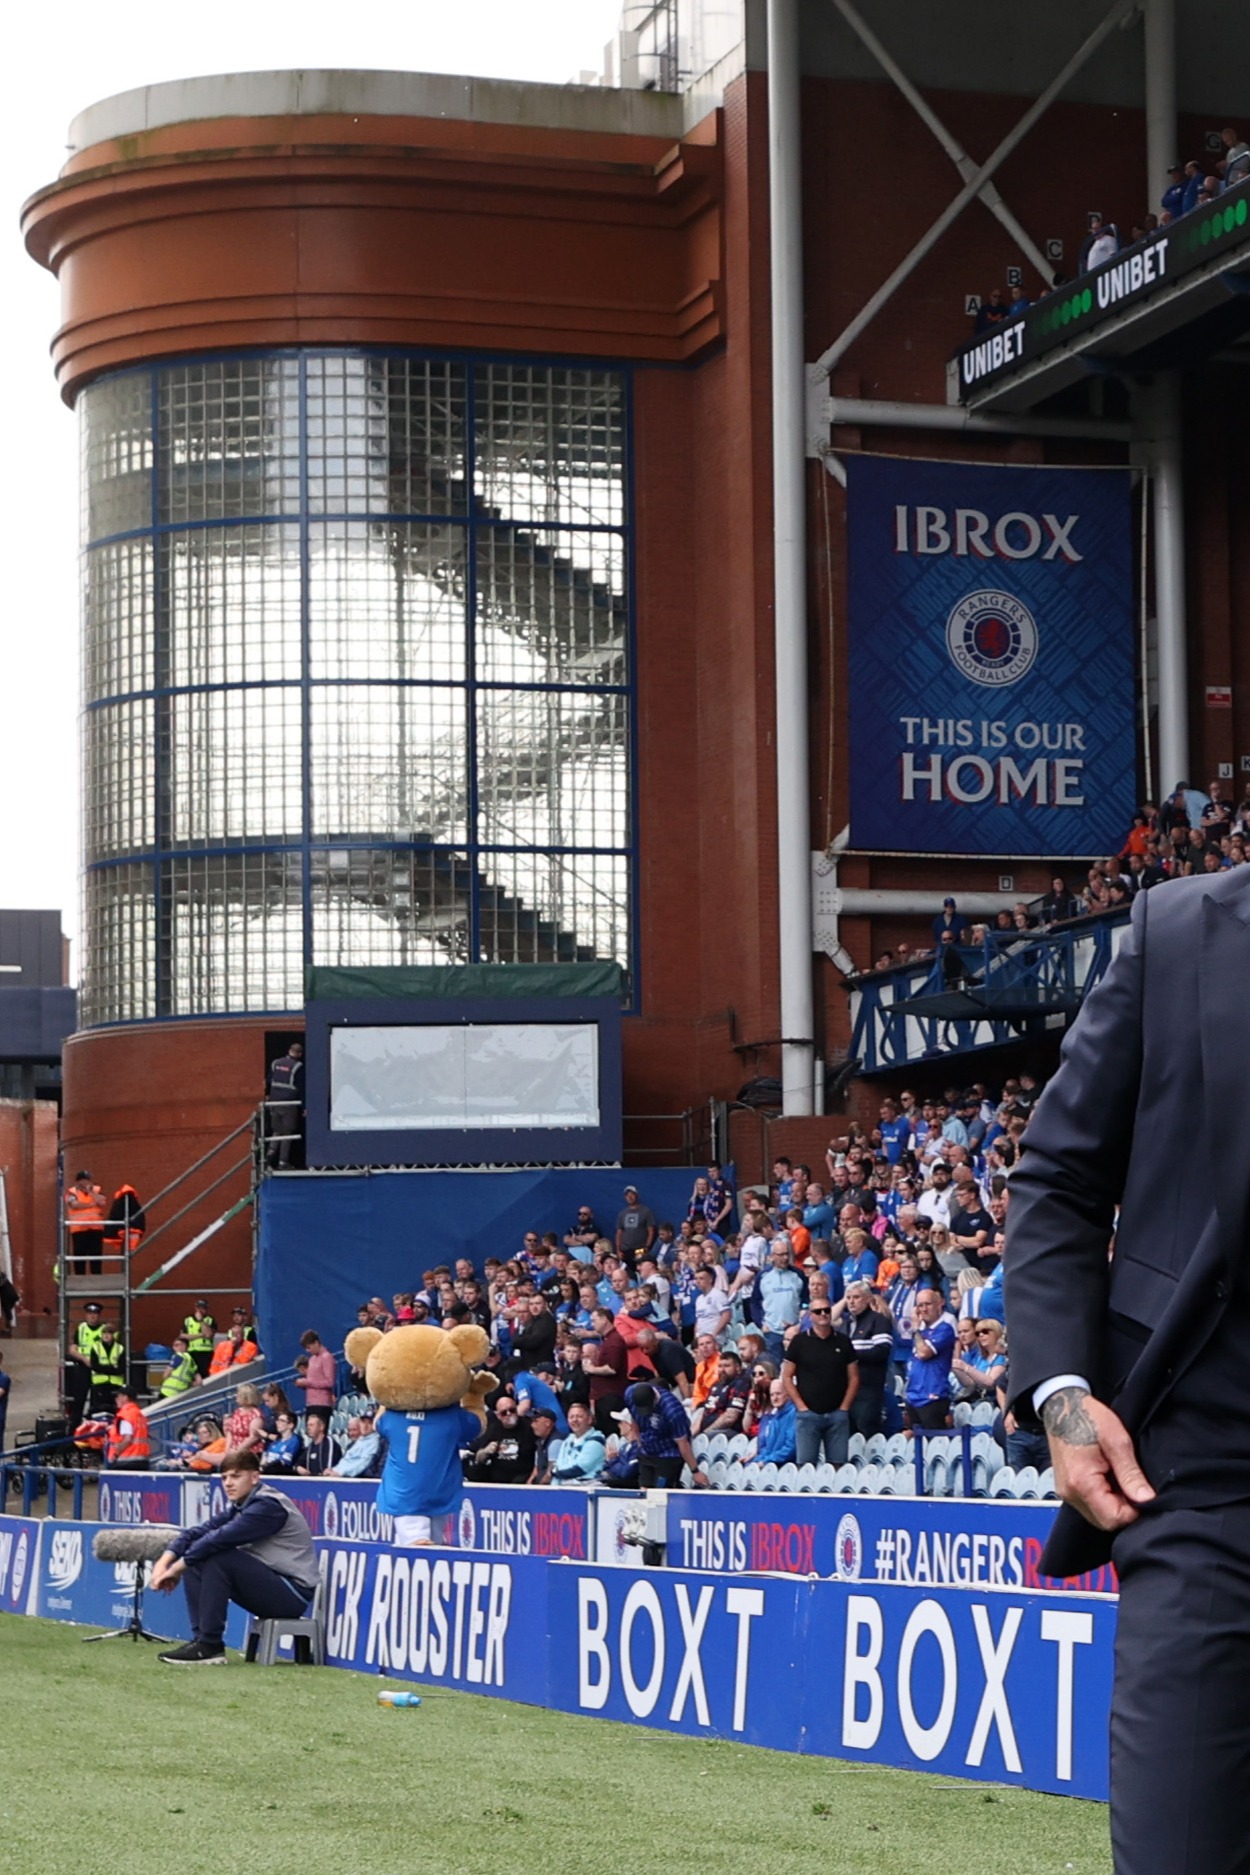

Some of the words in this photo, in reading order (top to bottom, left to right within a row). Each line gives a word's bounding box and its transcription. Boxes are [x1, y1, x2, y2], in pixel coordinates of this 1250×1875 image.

[1049, 241, 1062, 258] C
[1008, 269, 1021, 285] B
[1097, 238, 1168, 309] UNIBET
[967, 298, 981, 313] A
[963, 320, 1026, 384] UNIBET
[895, 504, 1084, 562] IBROX
[958, 595, 1027, 624] RANGERS
[954, 644, 1009, 680] FOOTBALL
[1008, 647, 1031, 675] CLUB
[900, 717, 974, 747] THIS
[981, 720, 1008, 748] IS
[1014, 722, 1087, 751] OUR
[902, 752, 1085, 805] HOME
[407, 1425, 420, 1463] 1
[114, 1490, 132, 1522] THIS
[341, 1501, 394, 1542] FOLLOW
[481, 1509, 514, 1553] THIS
[517, 1511, 531, 1555] IS
[534, 1513, 585, 1558] IBROX
[681, 1519, 724, 1570] THIS
[729, 1521, 747, 1571] IS
[752, 1522, 816, 1573] IBROX
[312, 1549, 367, 1661] ACK
[365, 1554, 512, 1687] ROOSTER
[578, 1576, 764, 1732] BOXT
[842, 1595, 1093, 1781] BOXT
